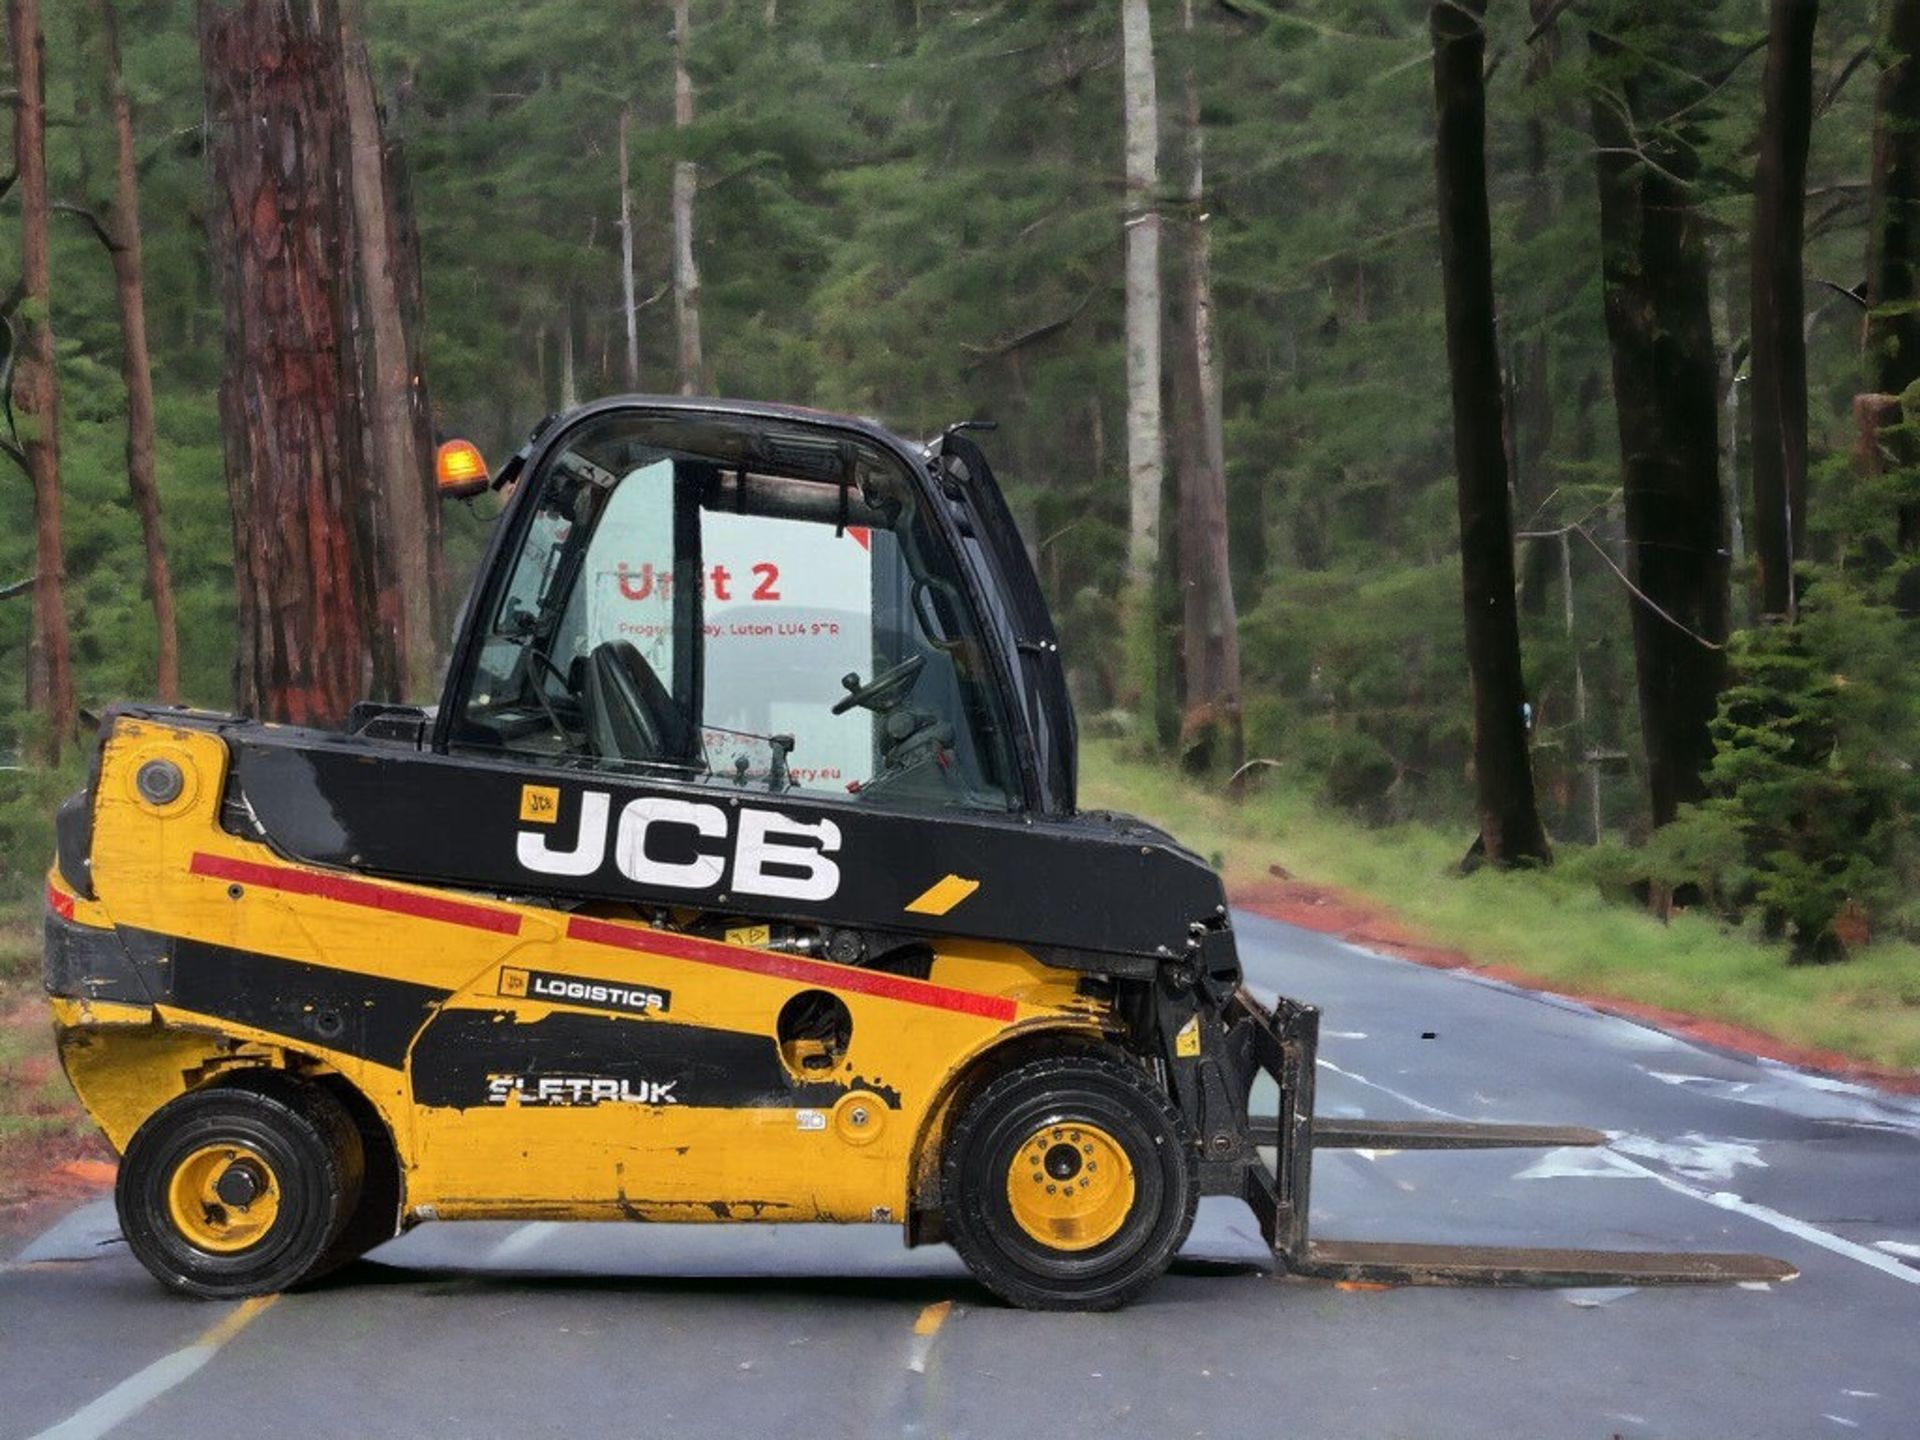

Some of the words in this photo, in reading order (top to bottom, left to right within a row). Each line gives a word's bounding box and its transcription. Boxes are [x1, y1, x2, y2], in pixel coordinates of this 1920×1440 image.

[617, 562, 731, 601] Ut
[752, 562, 780, 601] 2
[730, 623, 773, 635] Luton
[778, 623, 806, 635] LU4
[516, 790, 842, 901] JCB
[534, 978, 663, 1009] LOGISTICS
